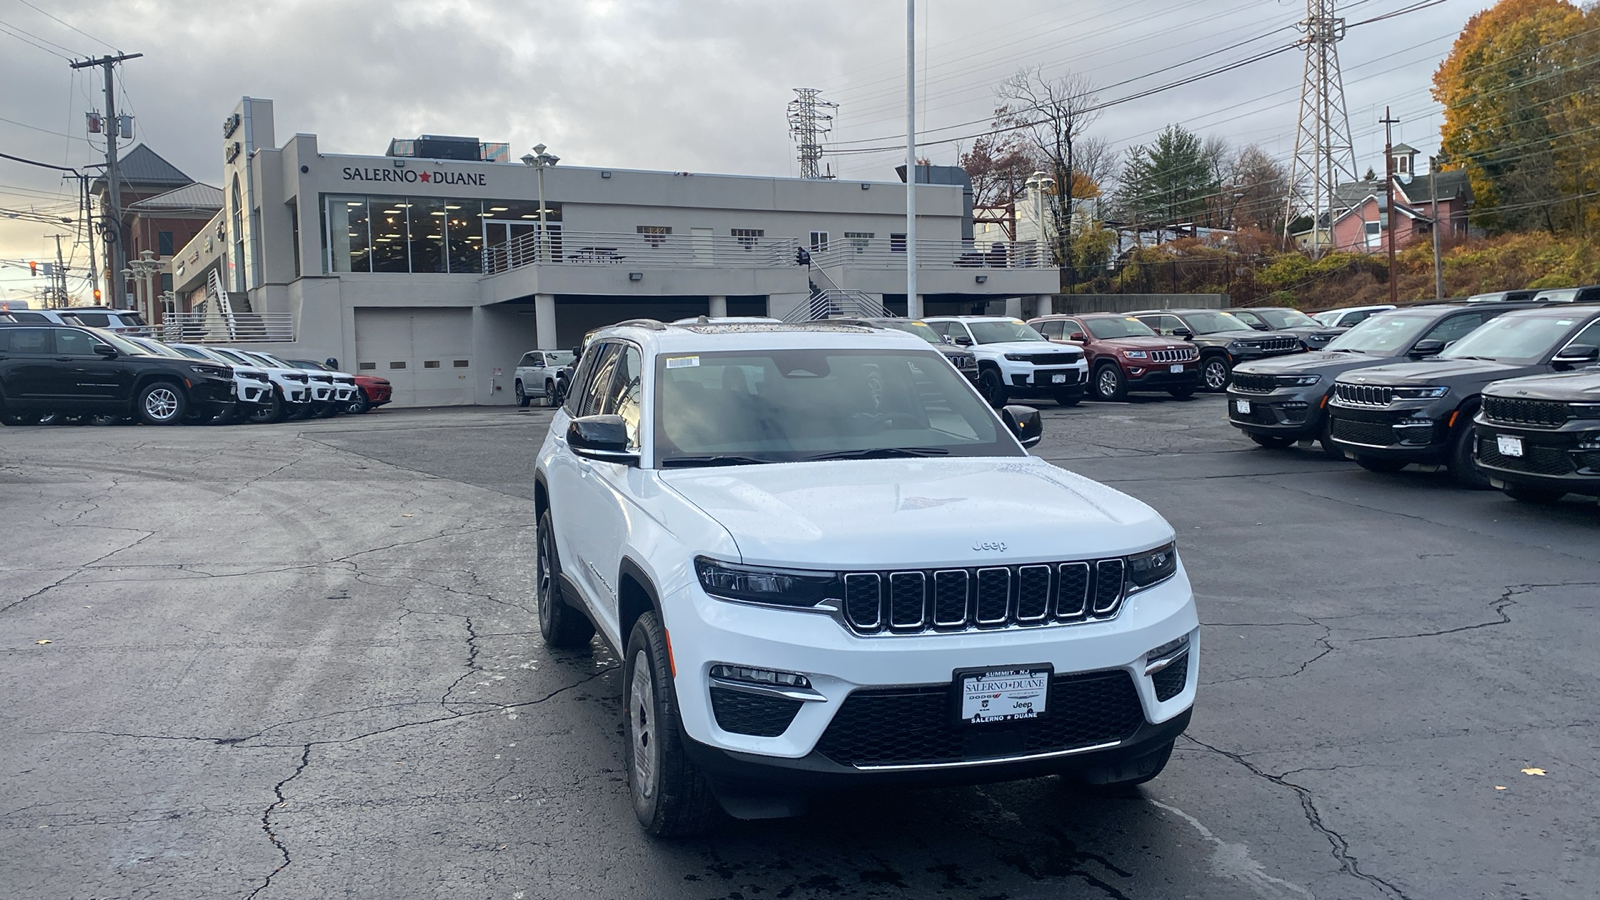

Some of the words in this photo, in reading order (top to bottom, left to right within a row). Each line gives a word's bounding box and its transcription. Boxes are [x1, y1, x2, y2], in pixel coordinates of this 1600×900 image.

[342, 167, 418, 183] SALERNO
[433, 171, 487, 186] DUANE
[971, 540, 1007, 552] Jeep
[965, 681, 1008, 693] SALERNO
[1012, 679, 1045, 689] DUANE
[1013, 701, 1032, 709] Jeep
[971, 715, 1004, 724] SALERNO
